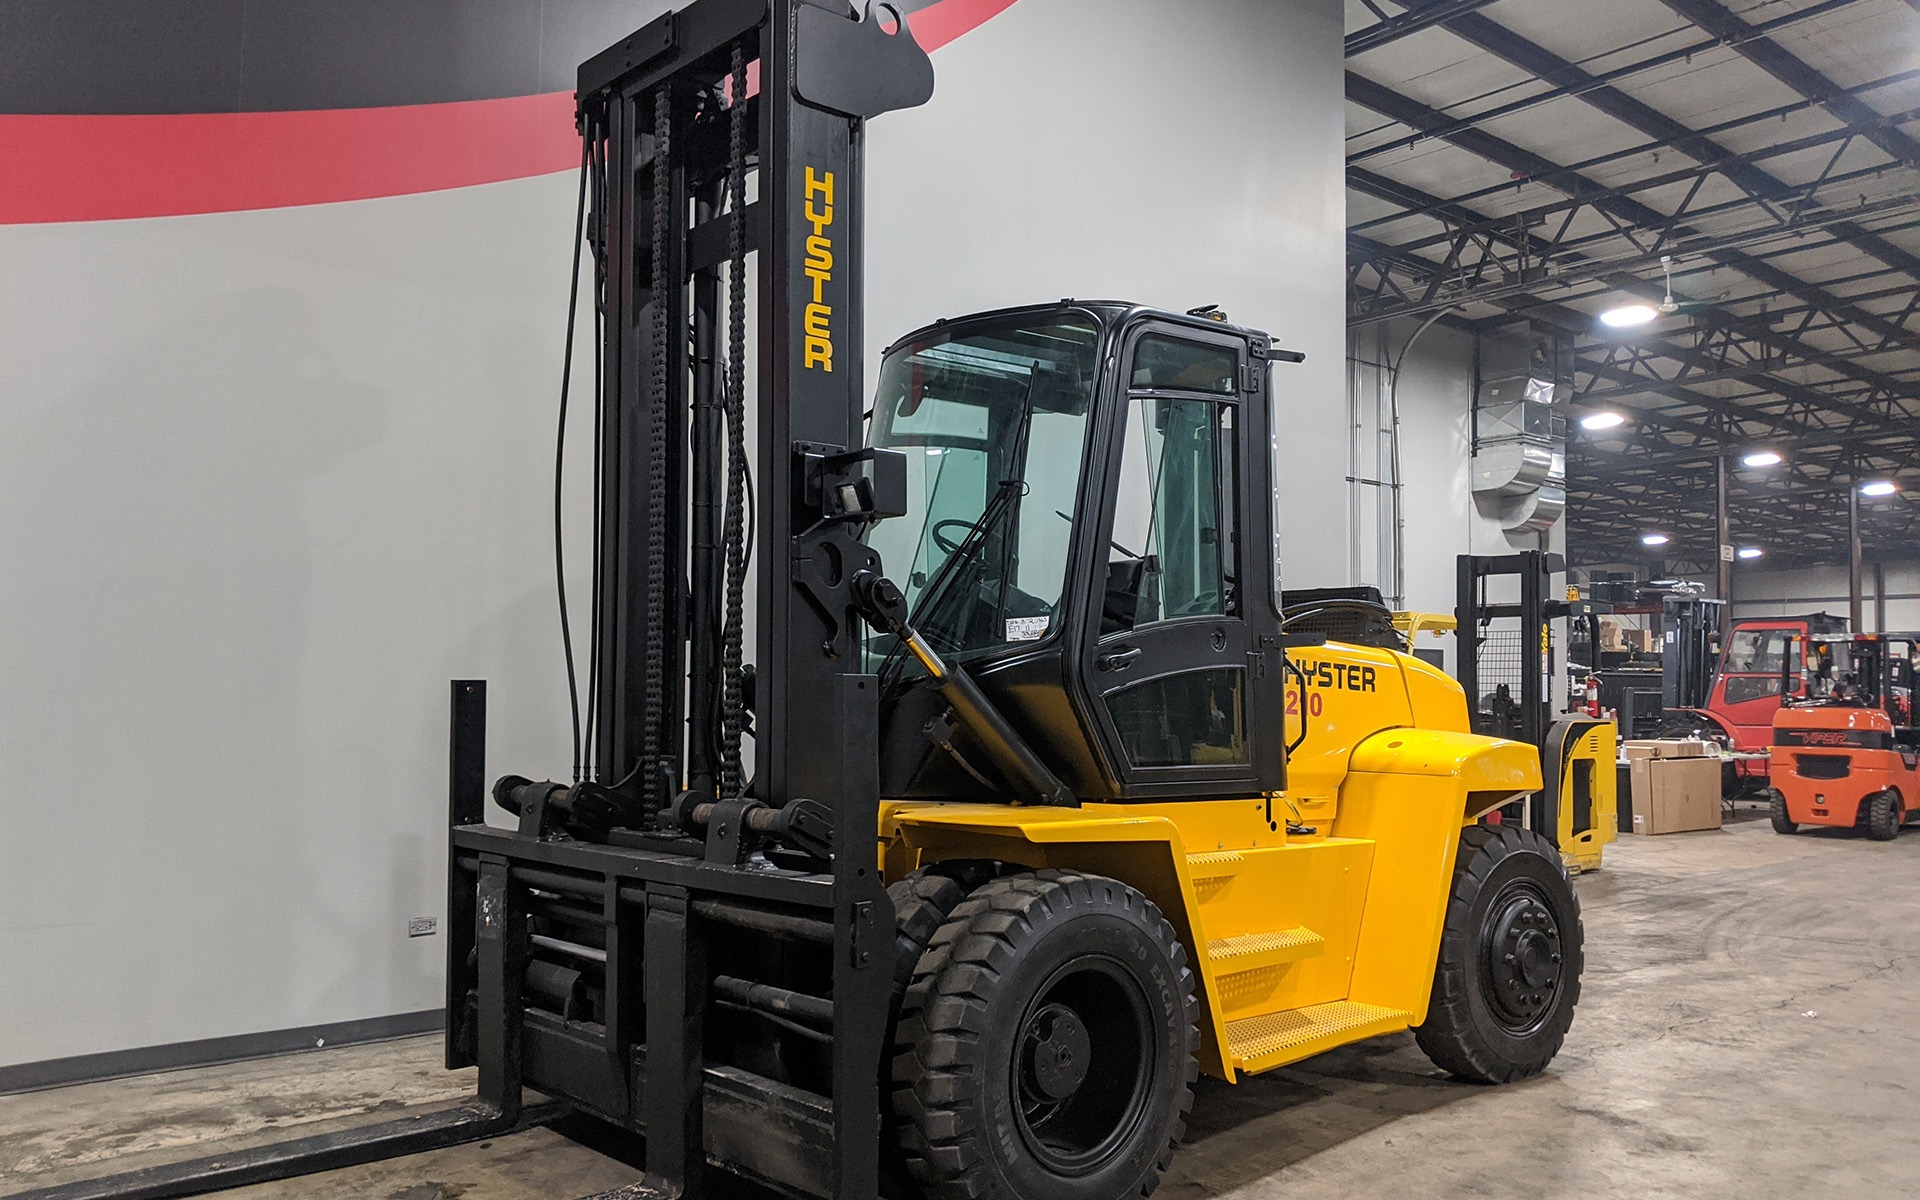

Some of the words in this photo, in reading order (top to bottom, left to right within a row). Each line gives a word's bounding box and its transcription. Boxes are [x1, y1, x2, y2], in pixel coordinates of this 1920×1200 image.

[804, 166, 834, 373] HYSTER
[1284, 659, 1376, 692] HYSTER
[1789, 731, 1862, 746] VIPER
